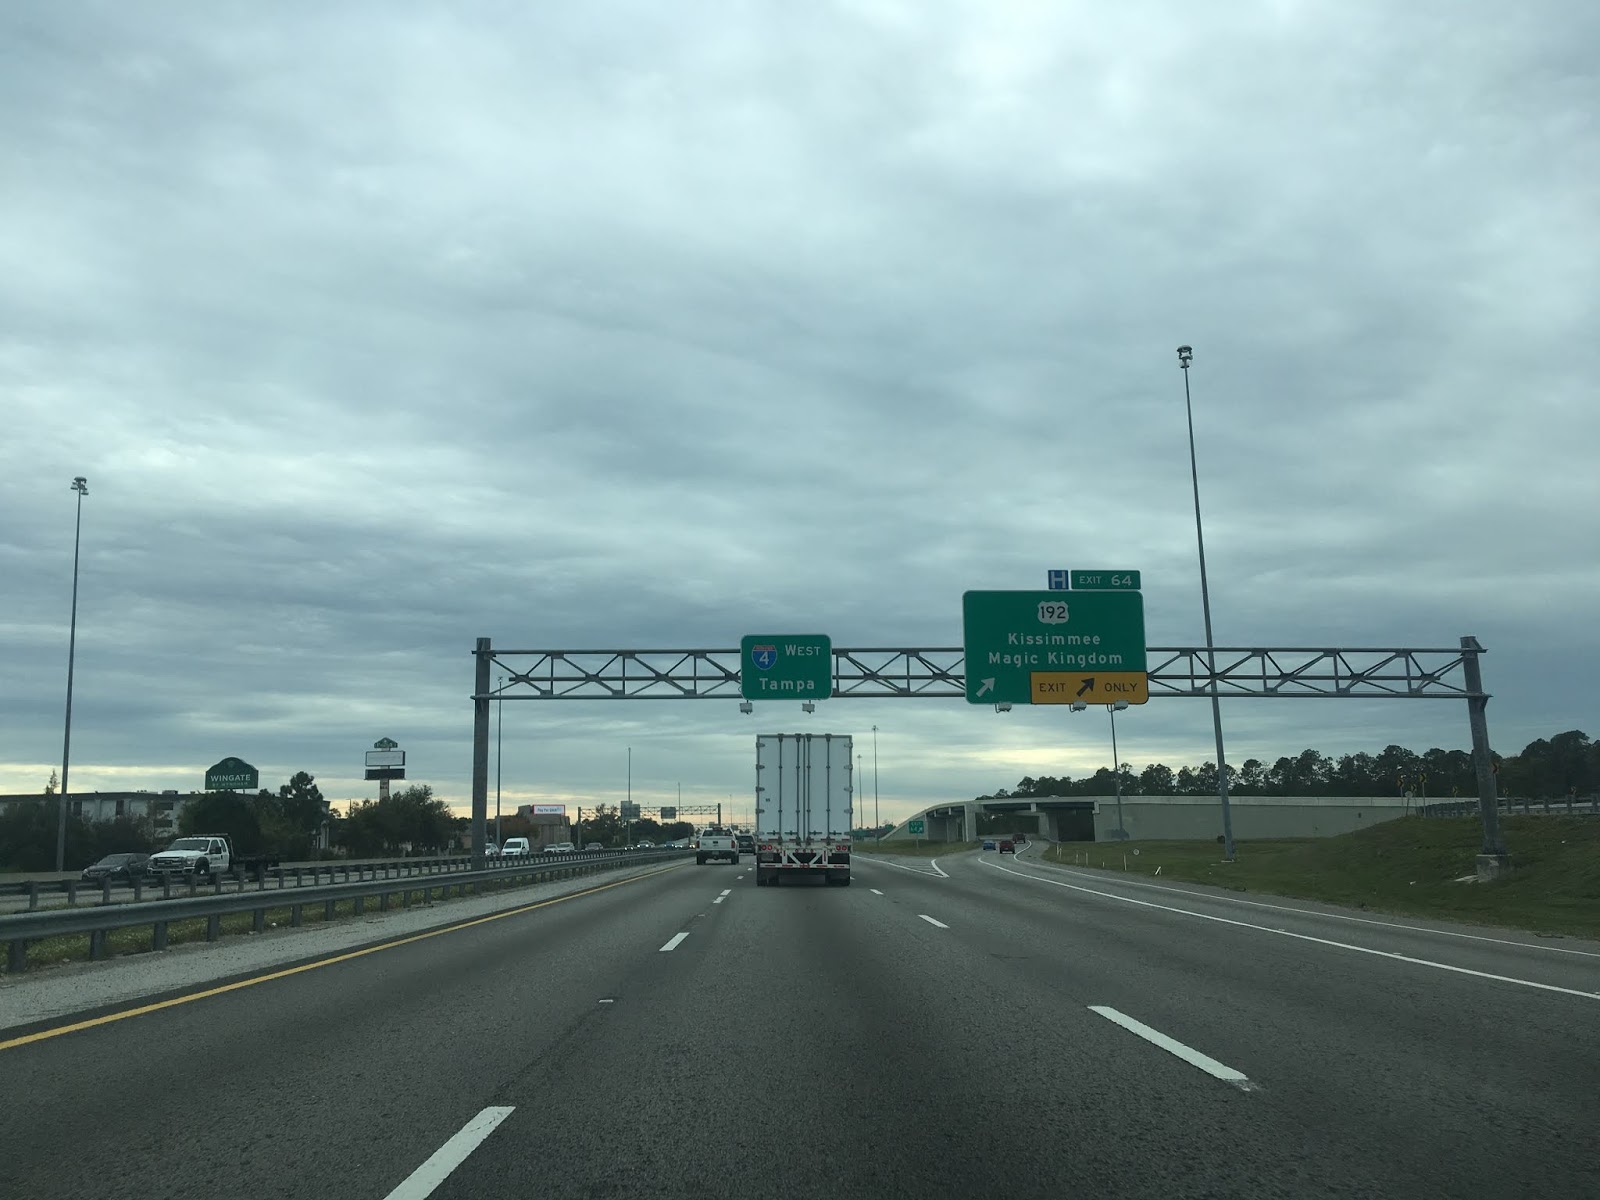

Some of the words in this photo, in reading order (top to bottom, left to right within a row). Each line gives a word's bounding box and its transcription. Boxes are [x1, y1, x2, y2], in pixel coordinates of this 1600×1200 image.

[1051, 571, 1066, 589] H
[1079, 575, 1101, 584] EXIT
[1111, 575, 1132, 586] 64
[1040, 606, 1066, 619] 192
[1008, 633, 1101, 645] Kissimmee
[759, 651, 770, 665] 4
[785, 644, 821, 656] WEST
[988, 652, 1038, 667] Magic
[1048, 652, 1122, 667] Kingdom
[759, 678, 815, 692] Tampa
[1039, 683, 1066, 692] EXIT
[1104, 683, 1137, 692] ONLY
[210, 774, 251, 782] WINGATE
